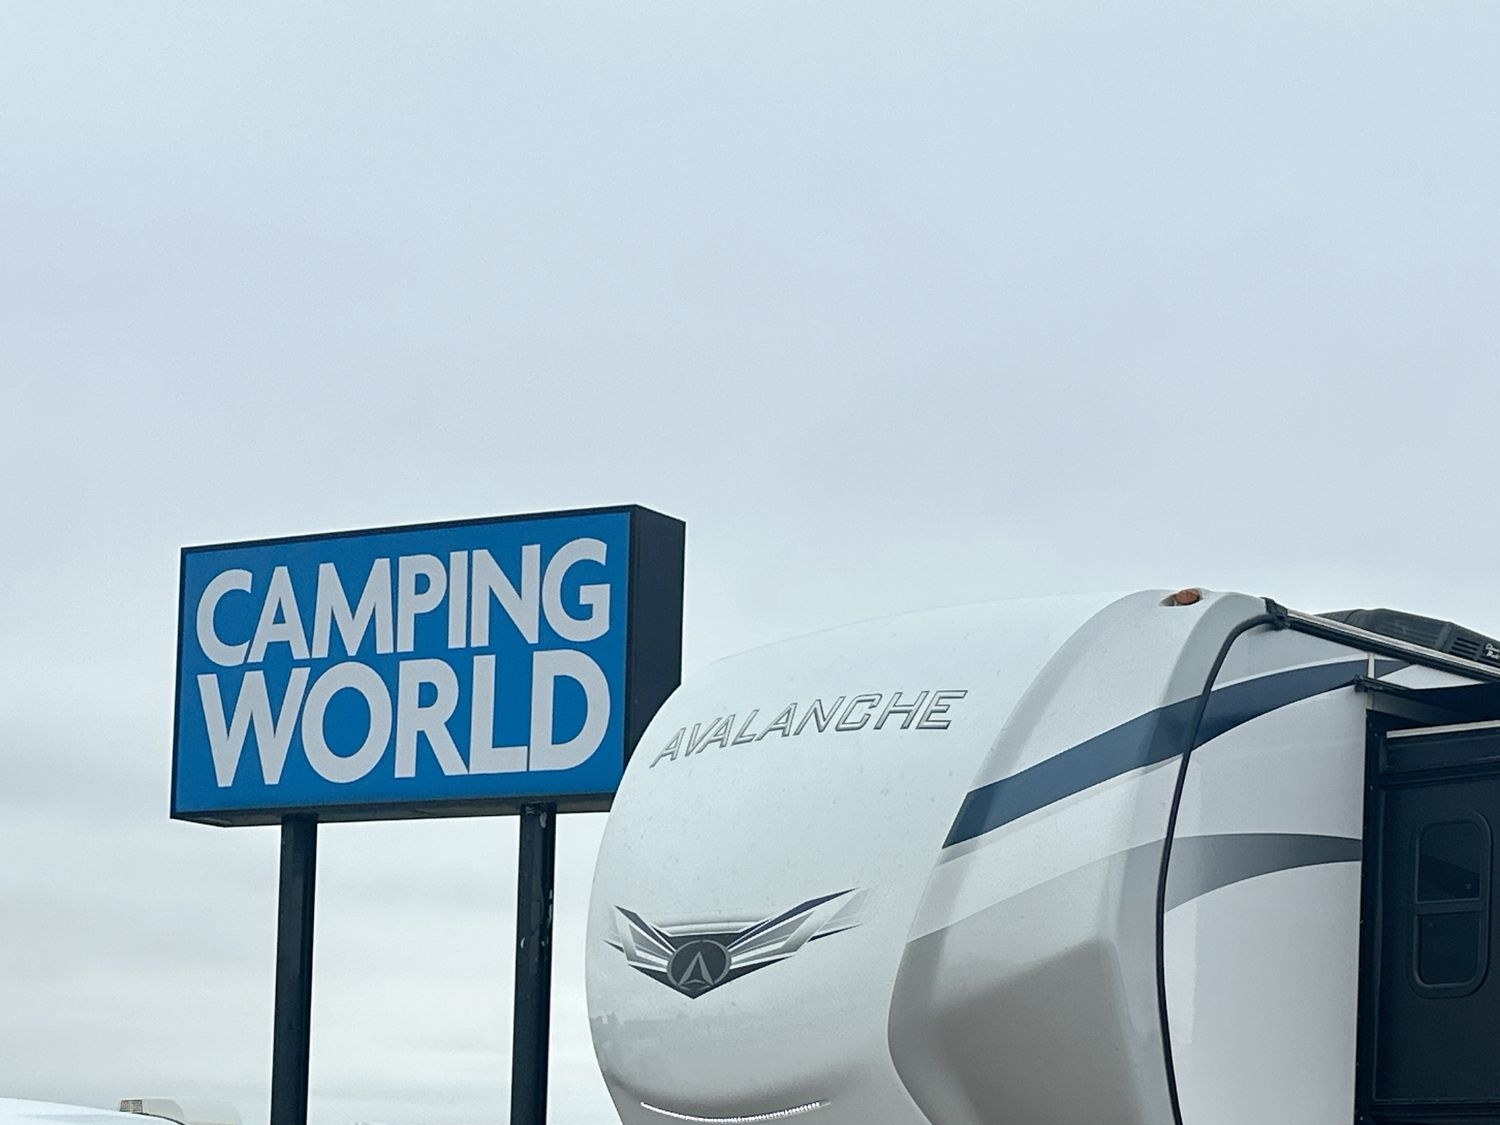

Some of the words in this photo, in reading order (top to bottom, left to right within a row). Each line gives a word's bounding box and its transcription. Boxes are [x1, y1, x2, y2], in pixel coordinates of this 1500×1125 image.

[196, 537, 611, 666] CAMPING
[196, 648, 611, 788] WORLD
[649, 690, 968, 768] AVALANCHE
